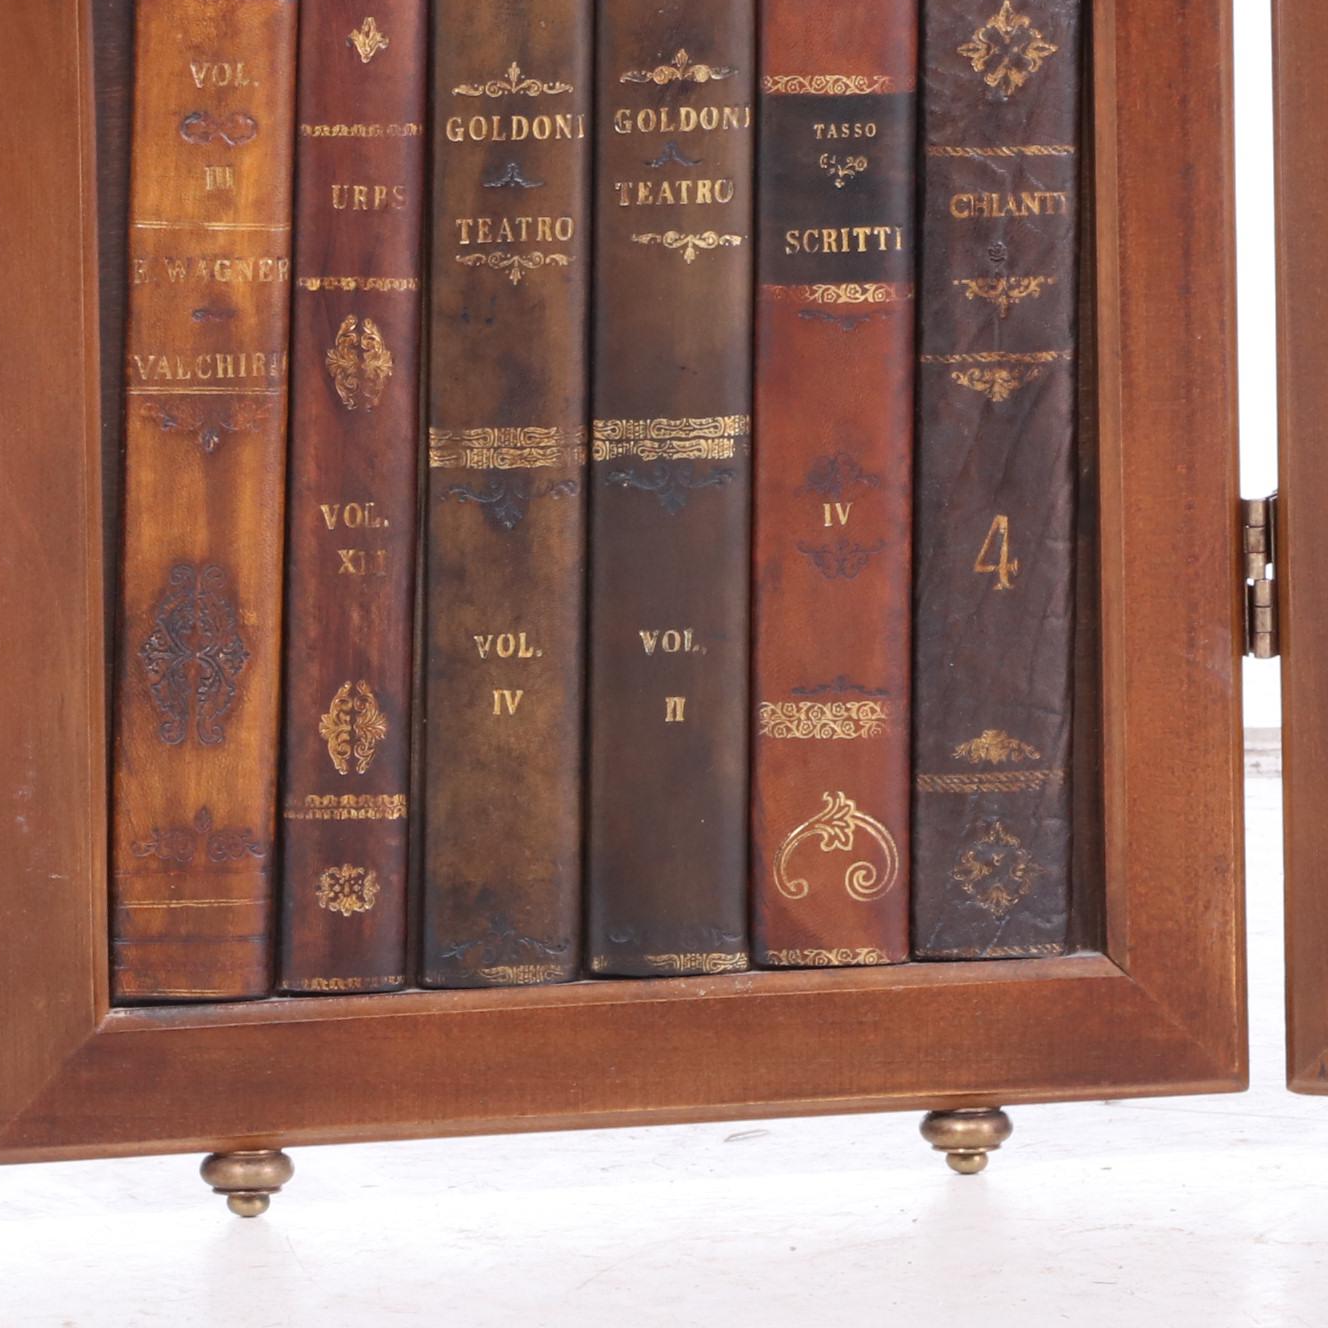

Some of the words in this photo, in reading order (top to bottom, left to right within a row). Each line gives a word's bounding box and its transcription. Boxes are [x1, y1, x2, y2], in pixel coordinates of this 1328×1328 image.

[189, 62, 261, 89] VOL.
[446, 112, 585, 144] GOLDONI
[613, 105, 751, 135] GOLDONI
[813, 121, 878, 140] TASSO
[615, 178, 735, 207] TEATRO
[949, 190, 1069, 220] CHIANTI
[455, 216, 574, 246] TEATRO
[785, 226, 904, 256] SCRITTI
[319, 501, 390, 531] VOL.
[822, 502, 854, 527] IV
[974, 514, 1020, 591] 4
[474, 632, 543, 660] VOL.
[492, 689, 524, 716] IV
[664, 695, 686, 723] II
